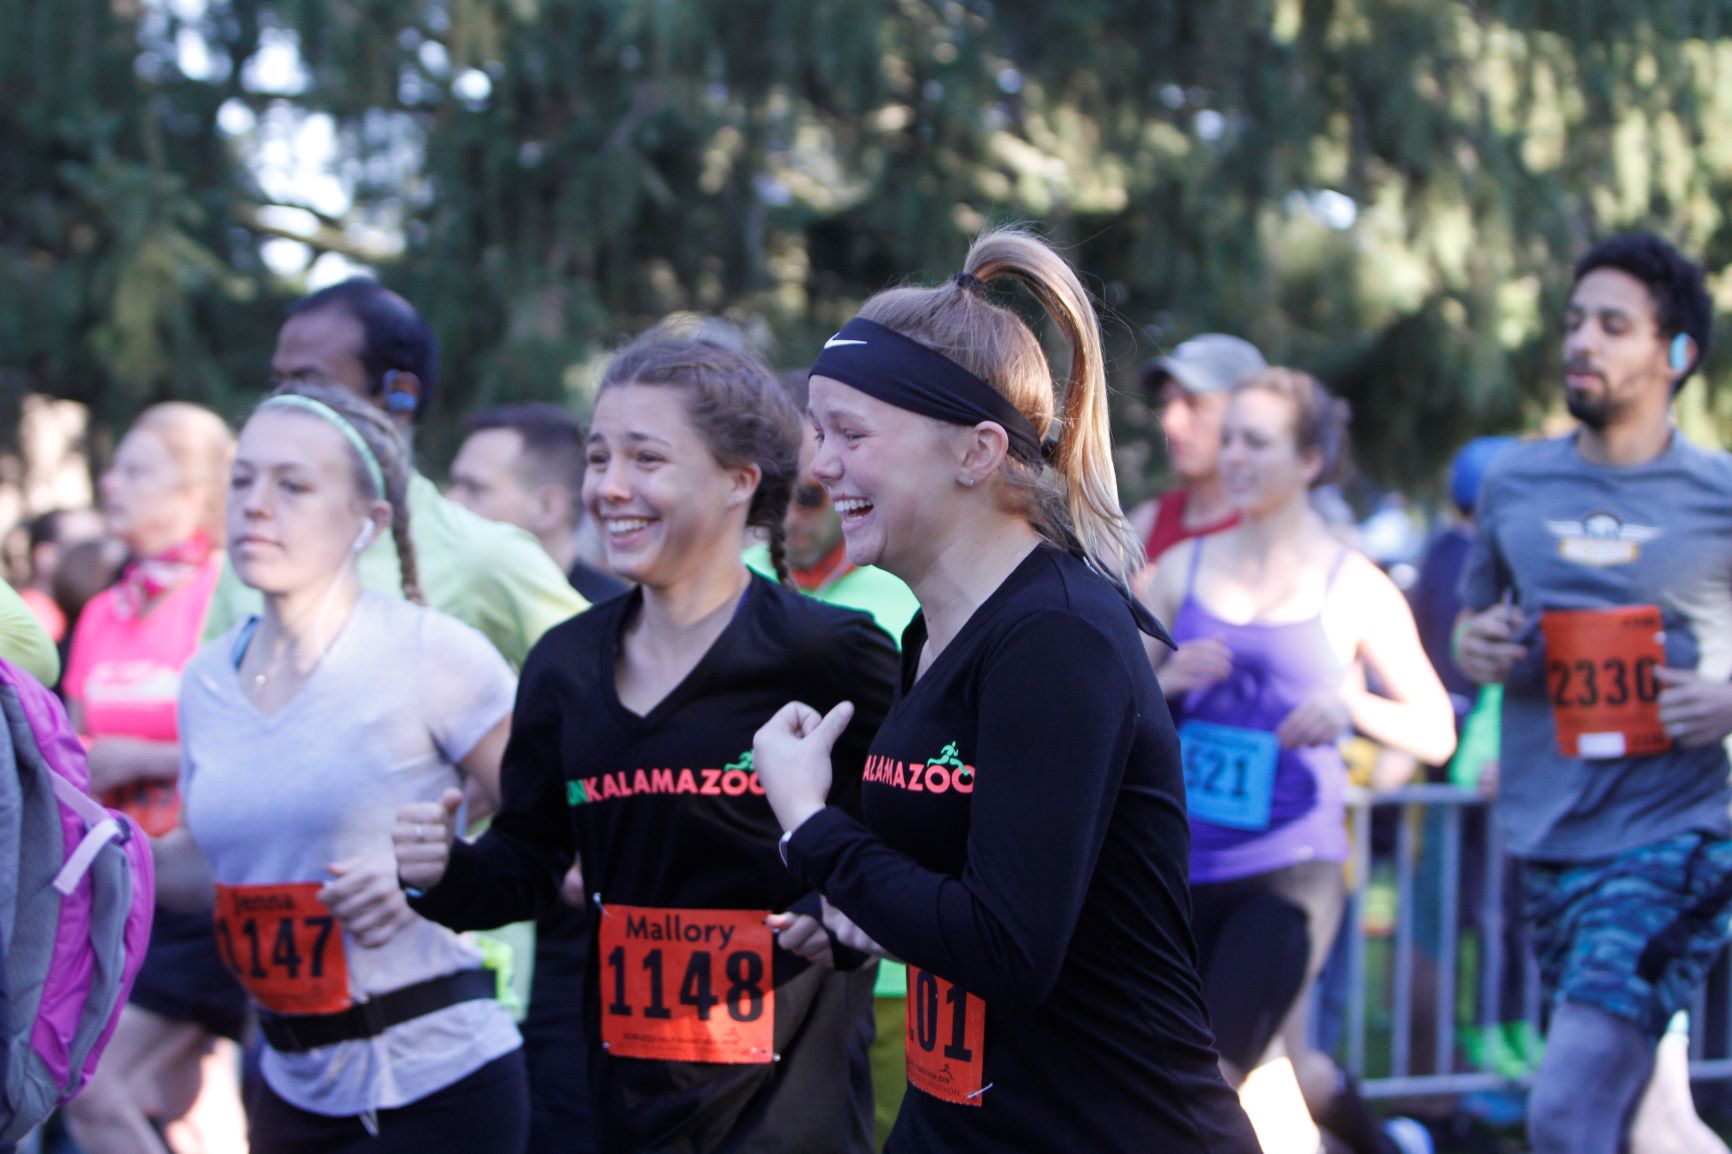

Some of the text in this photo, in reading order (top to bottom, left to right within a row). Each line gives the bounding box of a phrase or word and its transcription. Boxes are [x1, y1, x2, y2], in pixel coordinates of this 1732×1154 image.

[1549, 656, 1660, 708] 2330
[218, 916, 334, 980] 1147
[626, 913, 736, 950] Mallory
[608, 945, 764, 1022] 1148
[909, 970, 972, 1062] 01
